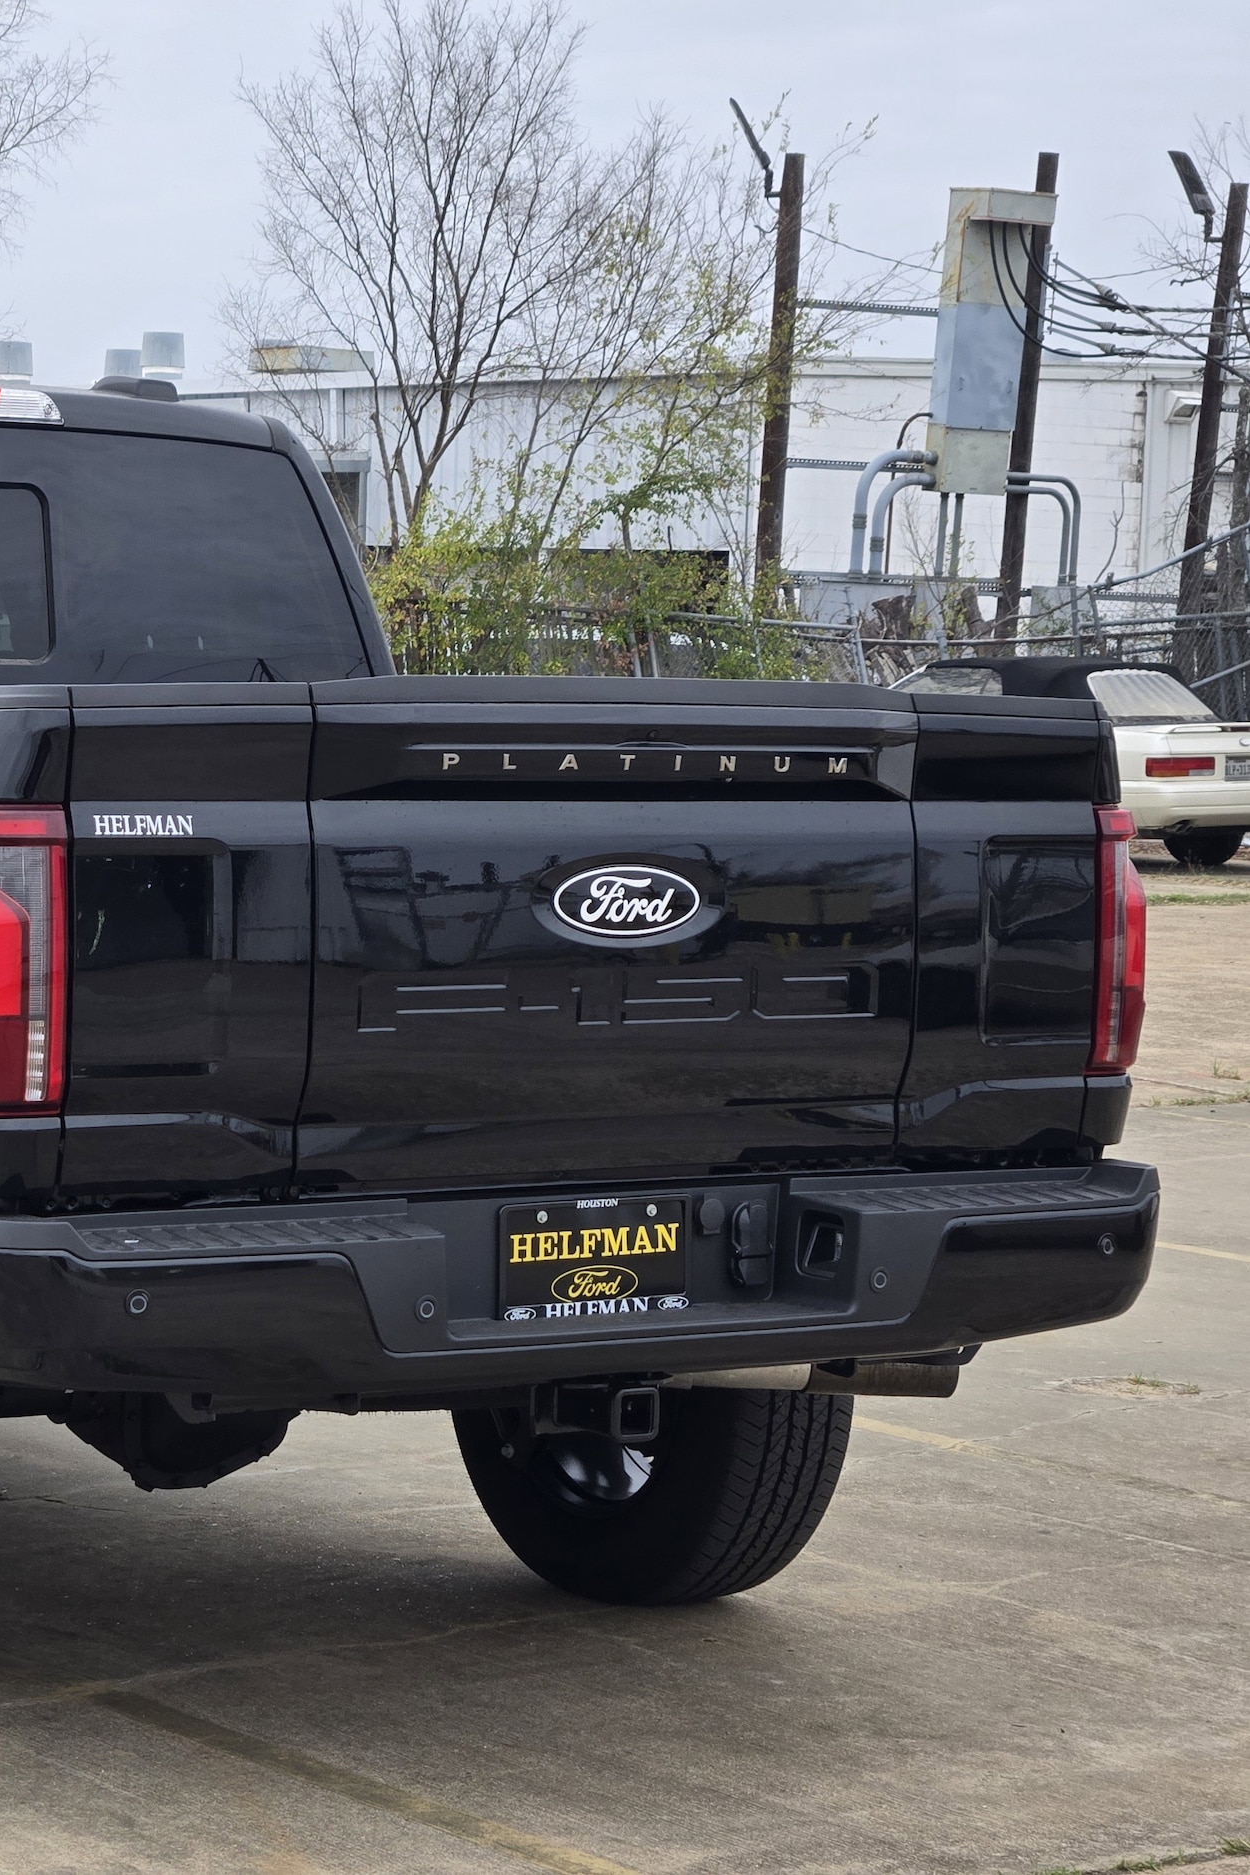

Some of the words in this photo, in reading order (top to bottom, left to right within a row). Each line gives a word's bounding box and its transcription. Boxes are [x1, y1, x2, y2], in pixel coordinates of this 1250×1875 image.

[442, 753, 849, 775] PLATINUM
[93, 815, 193, 836] HELFMAN
[580, 875, 675, 923] Ford
[357, 963, 879, 1032] F-150
[576, 1198, 619, 1209] HOUSTON
[509, 1222, 680, 1263] HELFMAN
[568, 1270, 622, 1298] Ford
